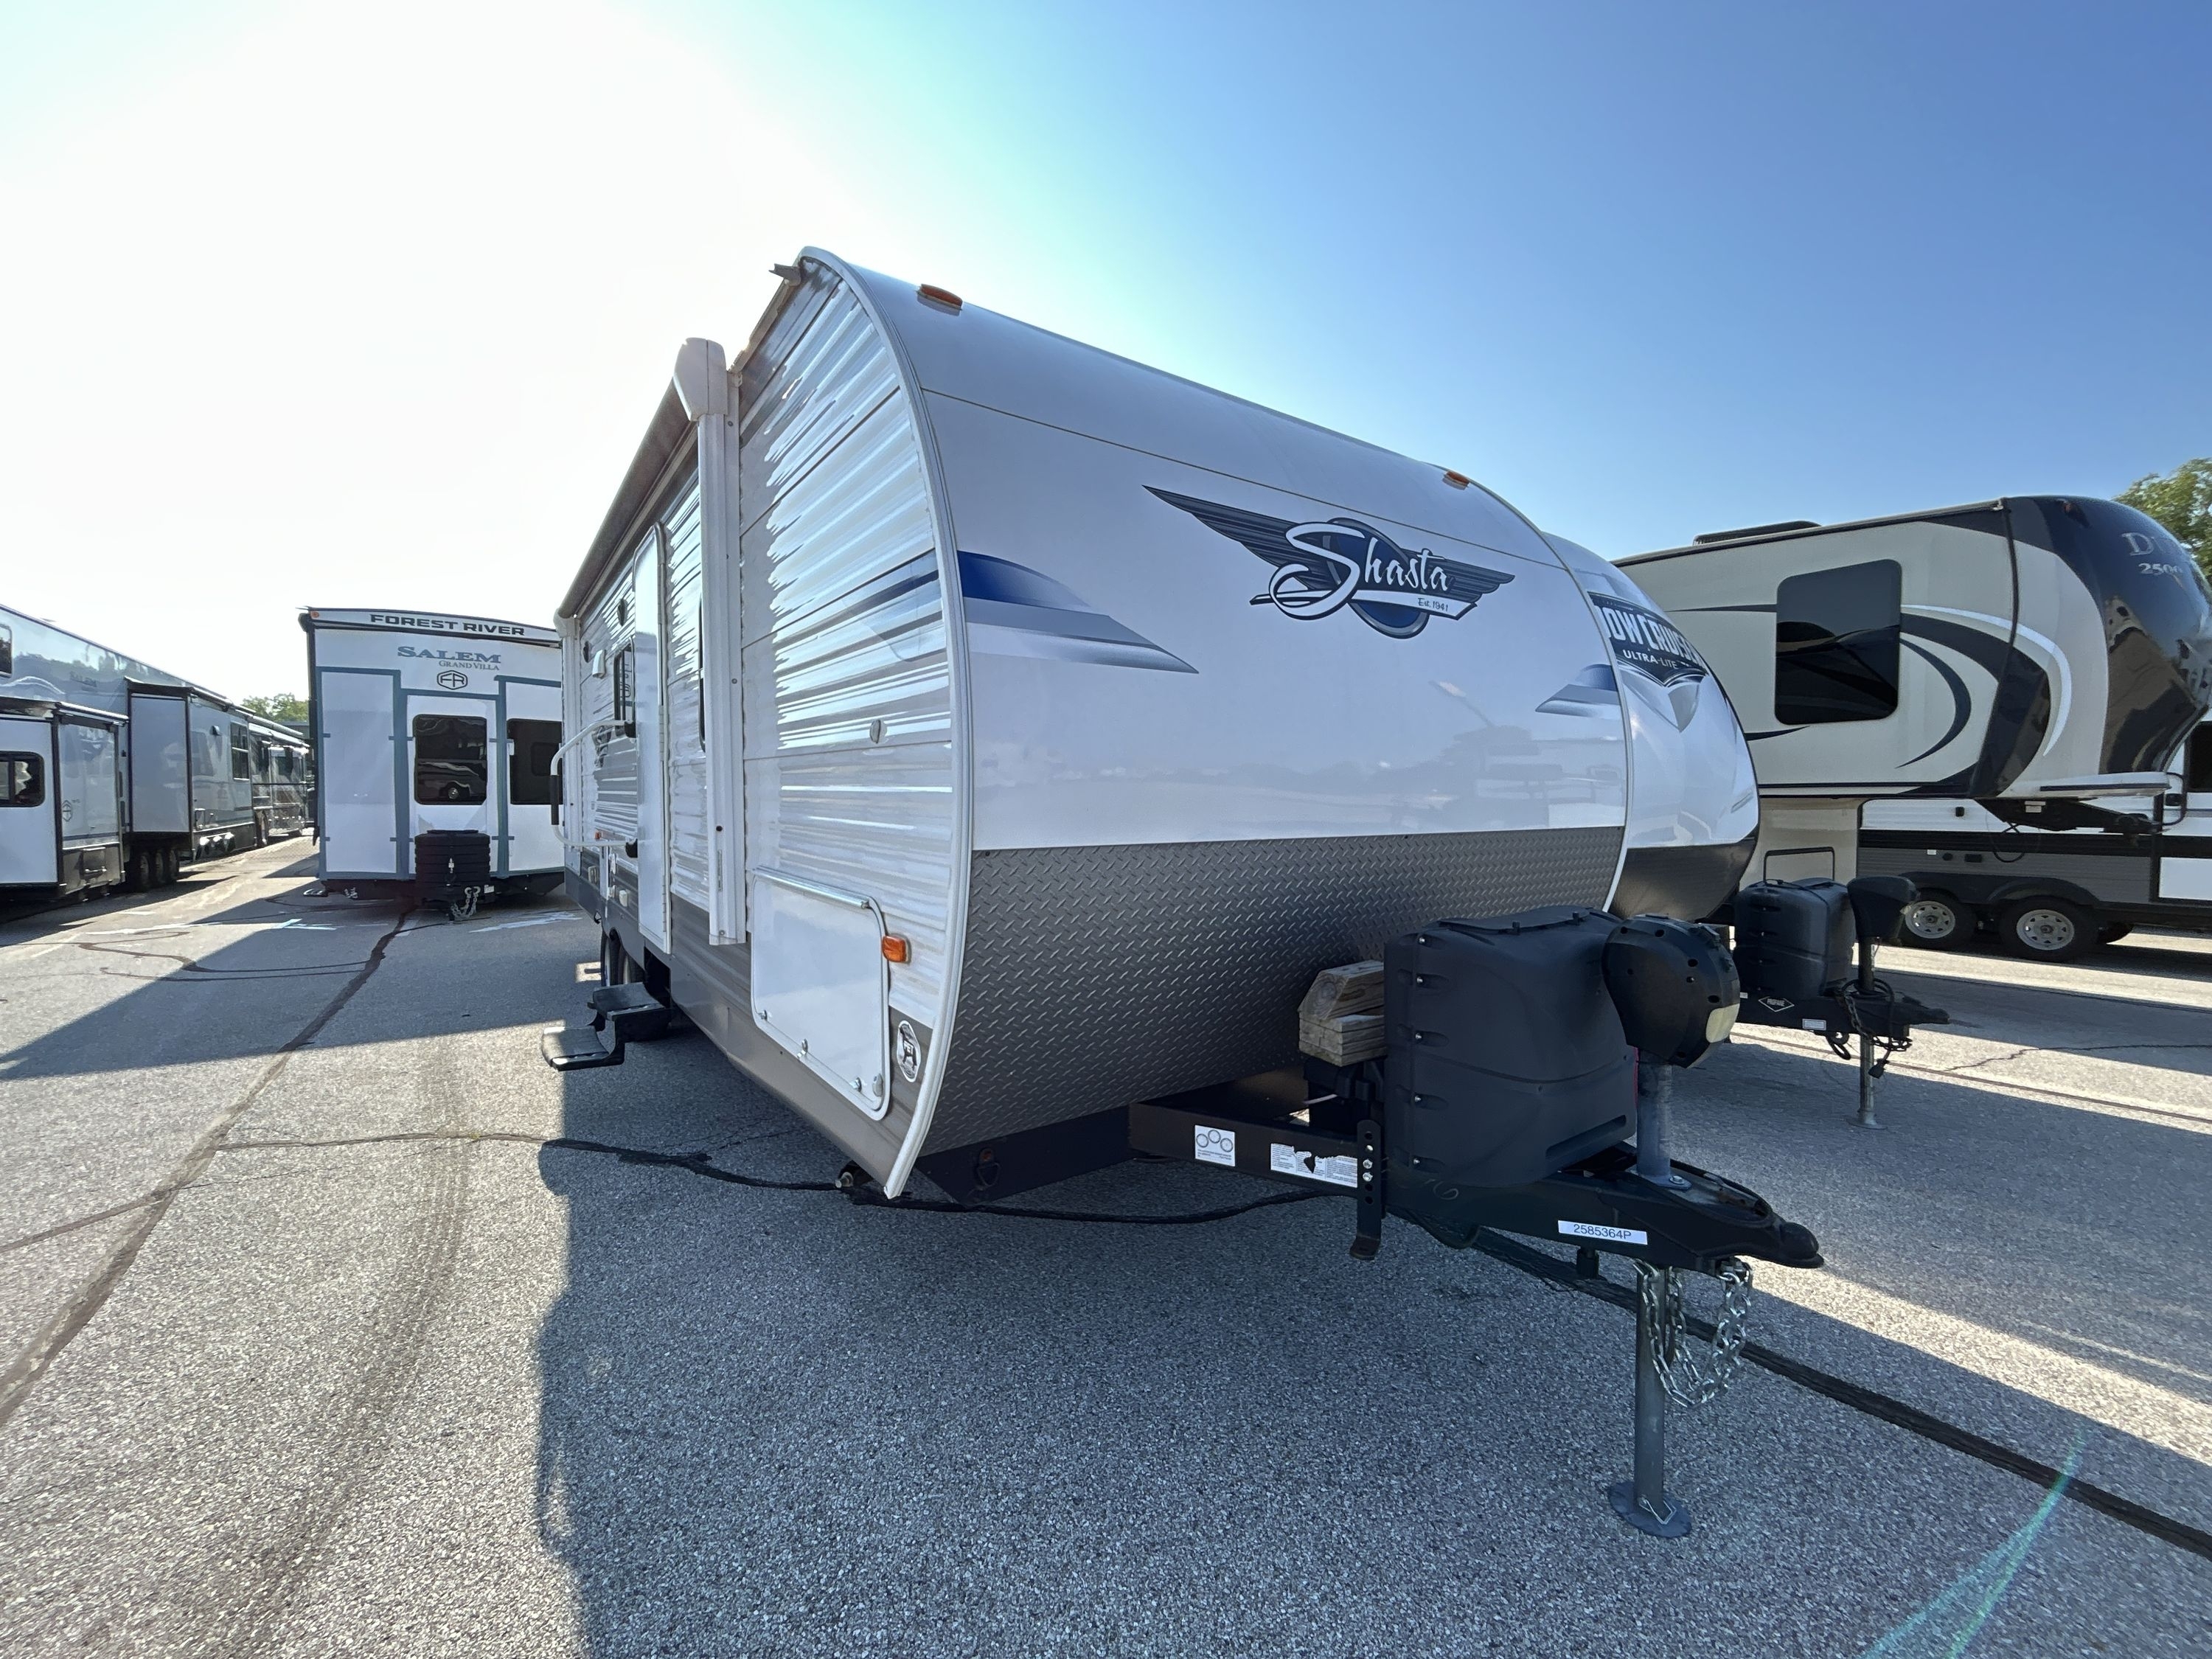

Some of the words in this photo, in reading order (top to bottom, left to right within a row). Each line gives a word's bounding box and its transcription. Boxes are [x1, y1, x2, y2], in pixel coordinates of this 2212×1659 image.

[1269, 522, 1448, 617] Shasta
[1432, 600, 1449, 612] 1941
[369, 613, 458, 630] FOREST
[463, 622, 525, 636] RIVER
[397, 646, 501, 664] SALEM
[1622, 649, 1679, 669] ULTRA-LITE
[439, 660, 472, 669] GRAND
[473, 662, 500, 671] VILLA
[1573, 1223, 1632, 1239] 2585364P
